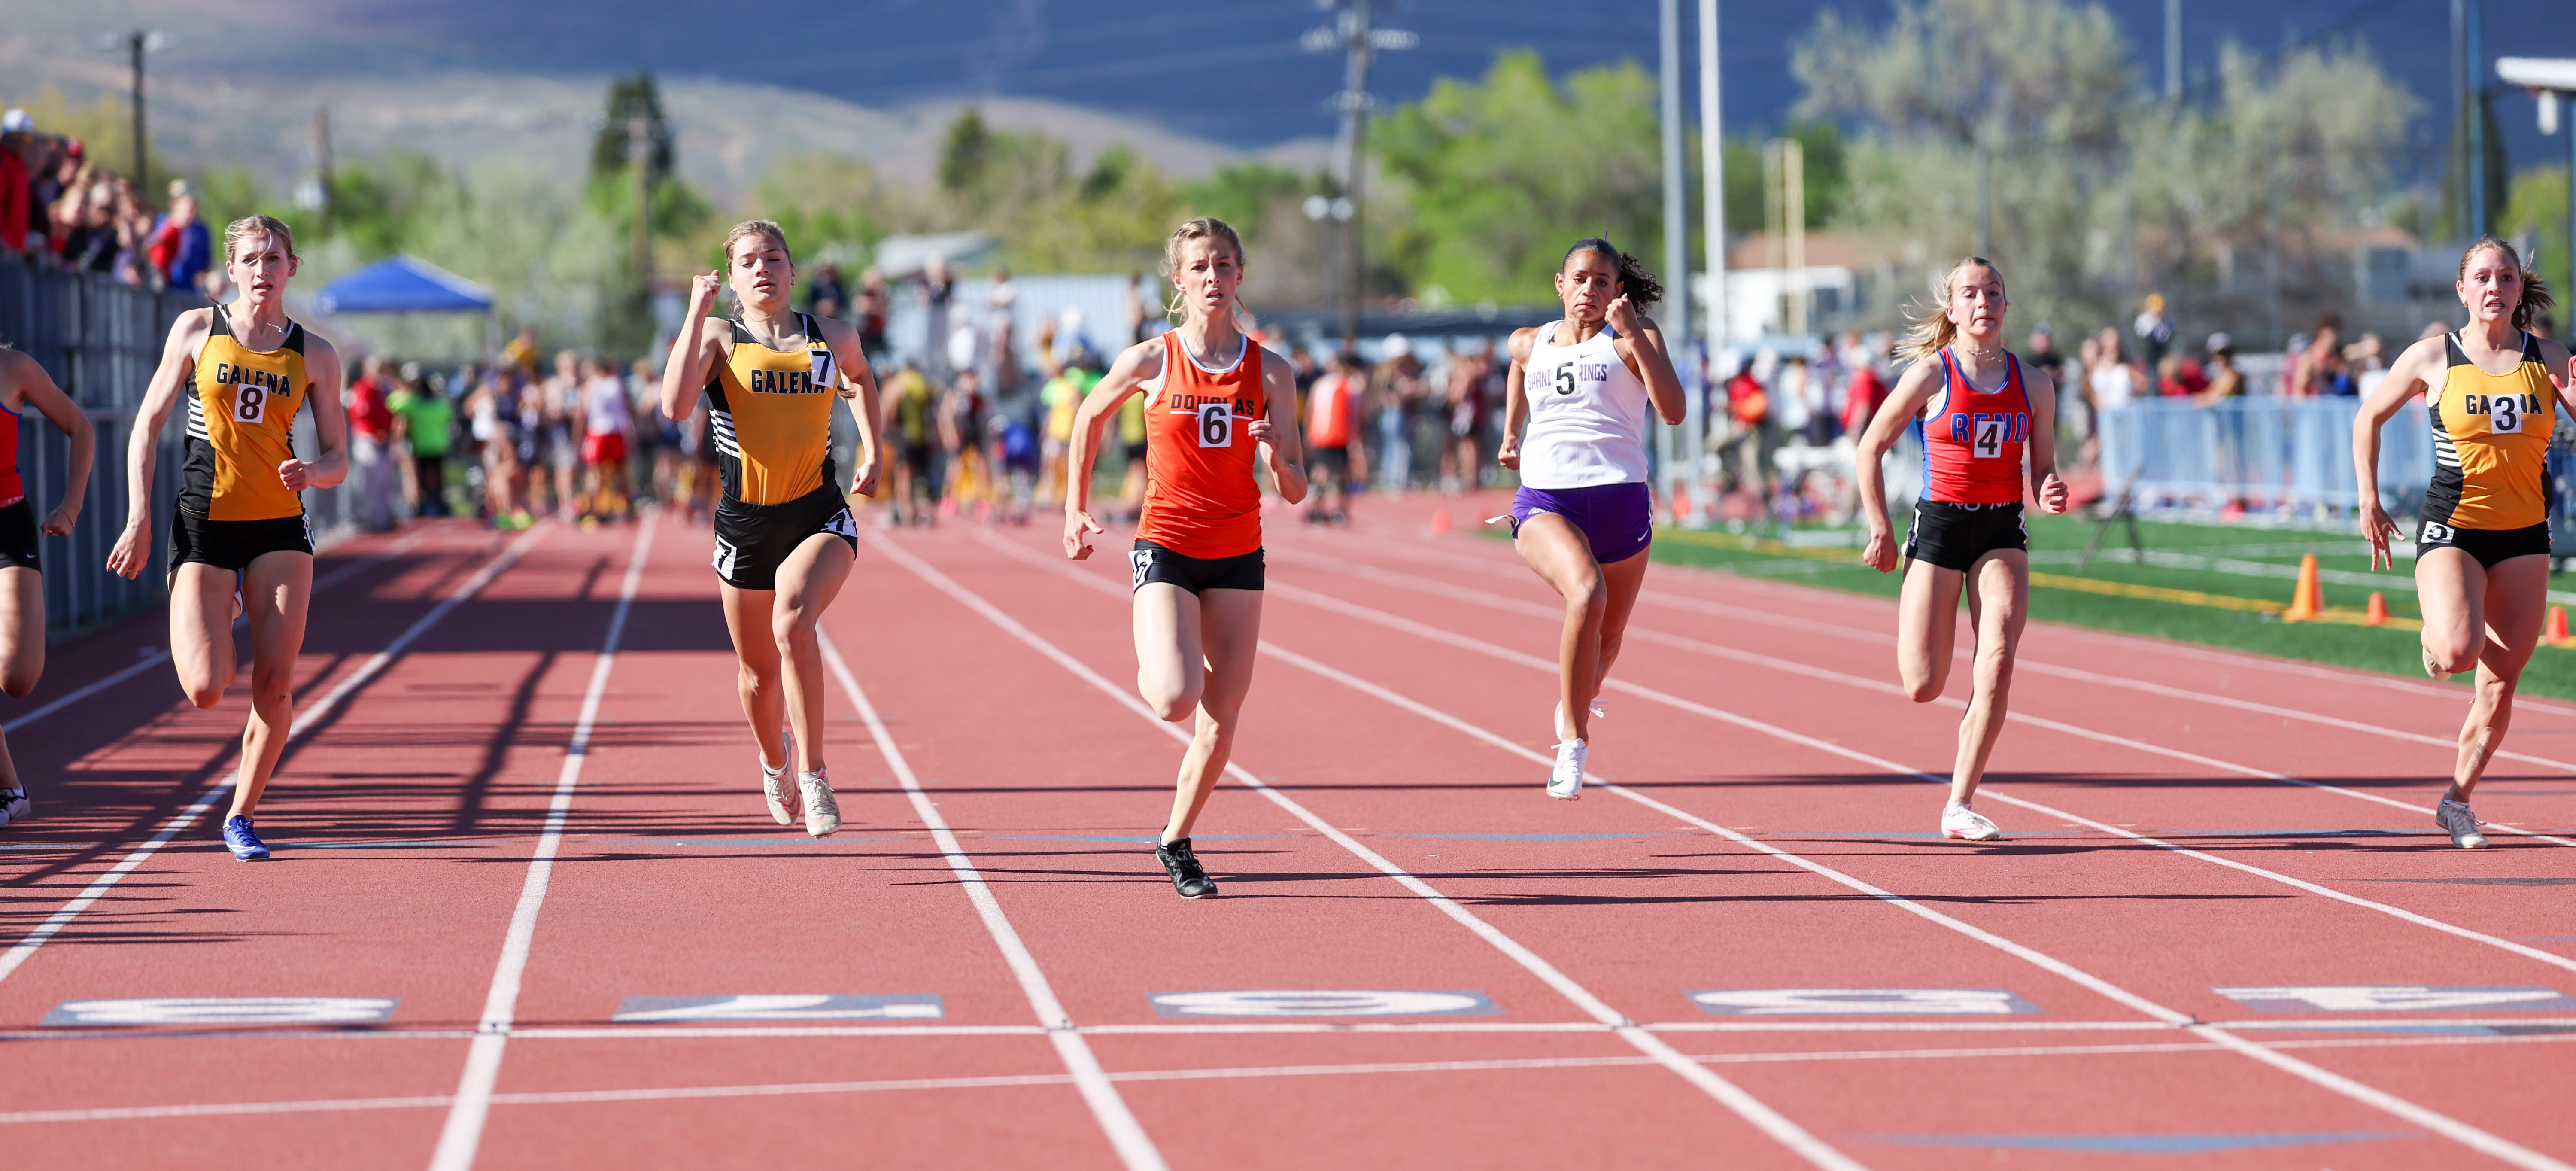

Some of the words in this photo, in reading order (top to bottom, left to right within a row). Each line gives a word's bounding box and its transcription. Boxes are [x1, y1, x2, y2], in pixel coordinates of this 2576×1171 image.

[216, 362, 291, 398] GALENA
[811, 350, 831, 383] 7
[1556, 361, 1575, 395] 5
[239, 387, 263, 420] 8
[2465, 393, 2543, 415] GANA
[2495, 396, 2517, 431] 3
[1203, 406, 1227, 444] 6
[1977, 423, 1998, 455] 4
[717, 539, 732, 570] 7
